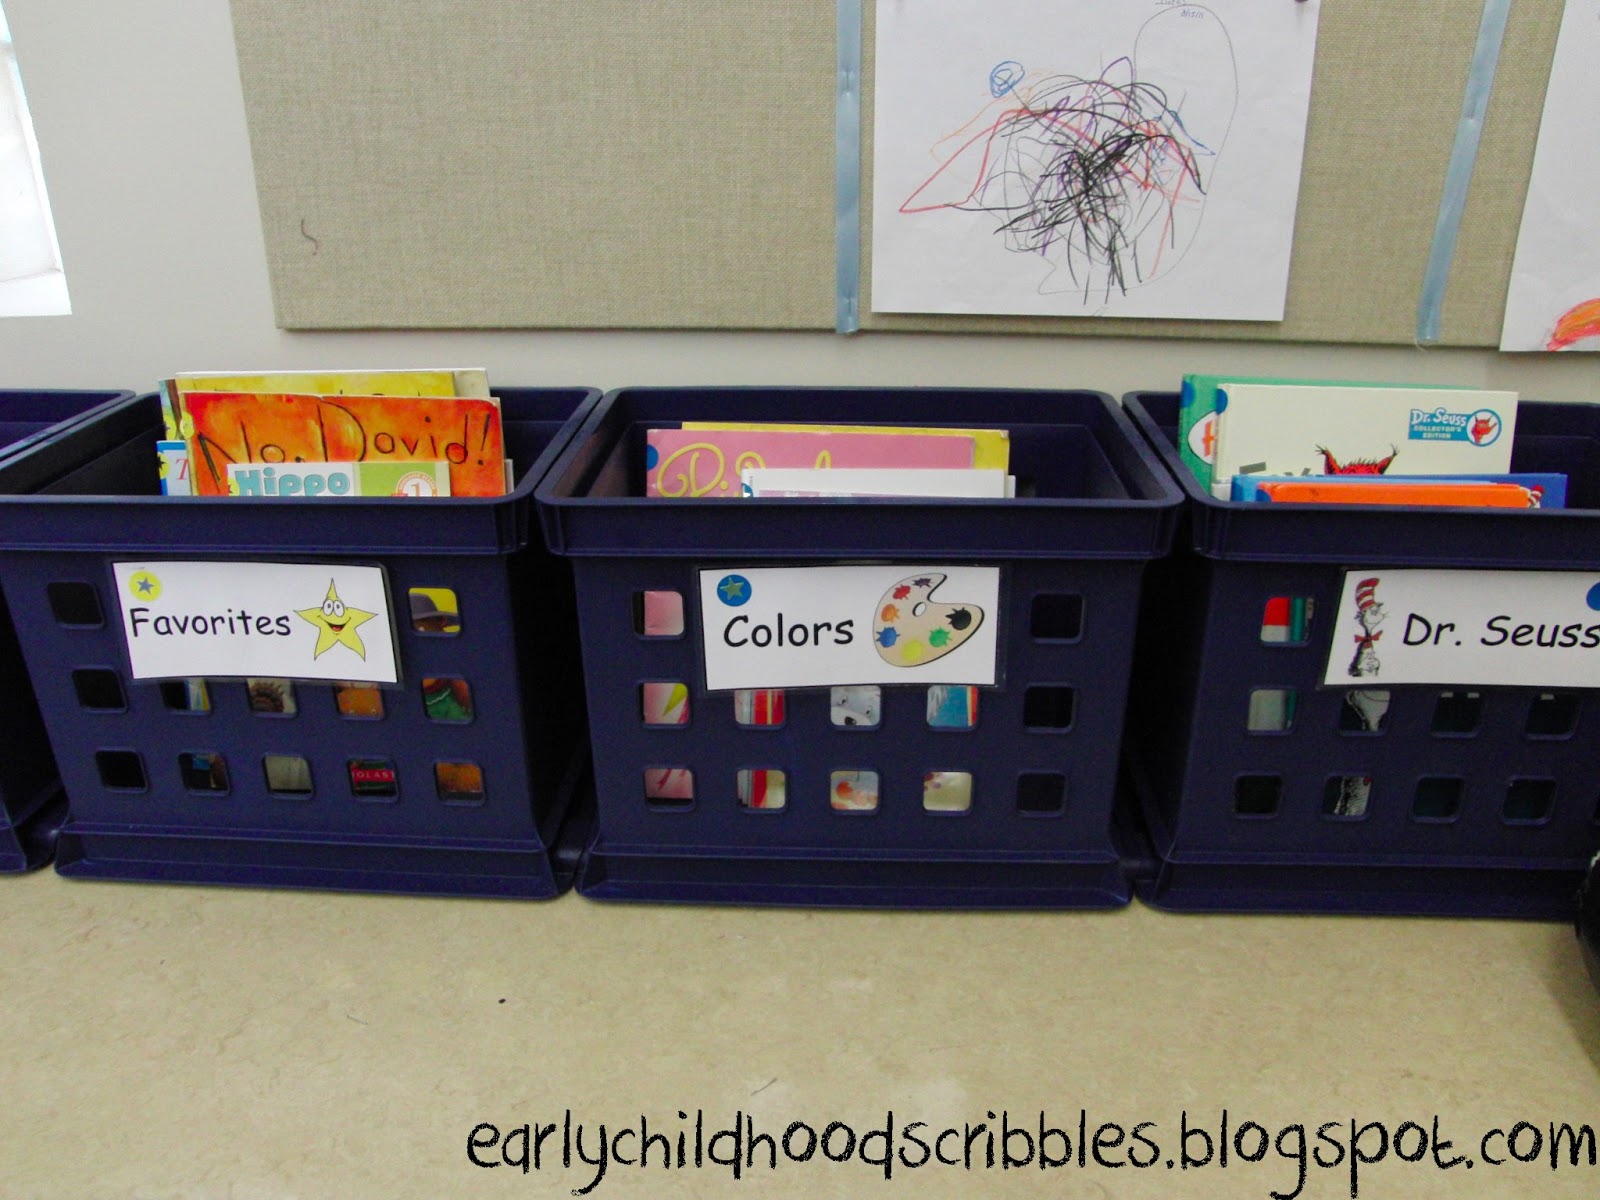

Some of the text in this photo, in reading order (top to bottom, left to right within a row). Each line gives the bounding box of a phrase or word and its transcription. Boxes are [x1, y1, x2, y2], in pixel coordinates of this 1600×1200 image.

[317, 400, 491, 465] David!
[1411, 408, 1467, 427] Dr. Seuss
[234, 466, 351, 497] Hippo
[129, 607, 291, 638] Favorites
[723, 612, 855, 648] Colors
[1402, 612, 1600, 649] Dr. Seuss
[352, 770, 395, 779] OLAS
